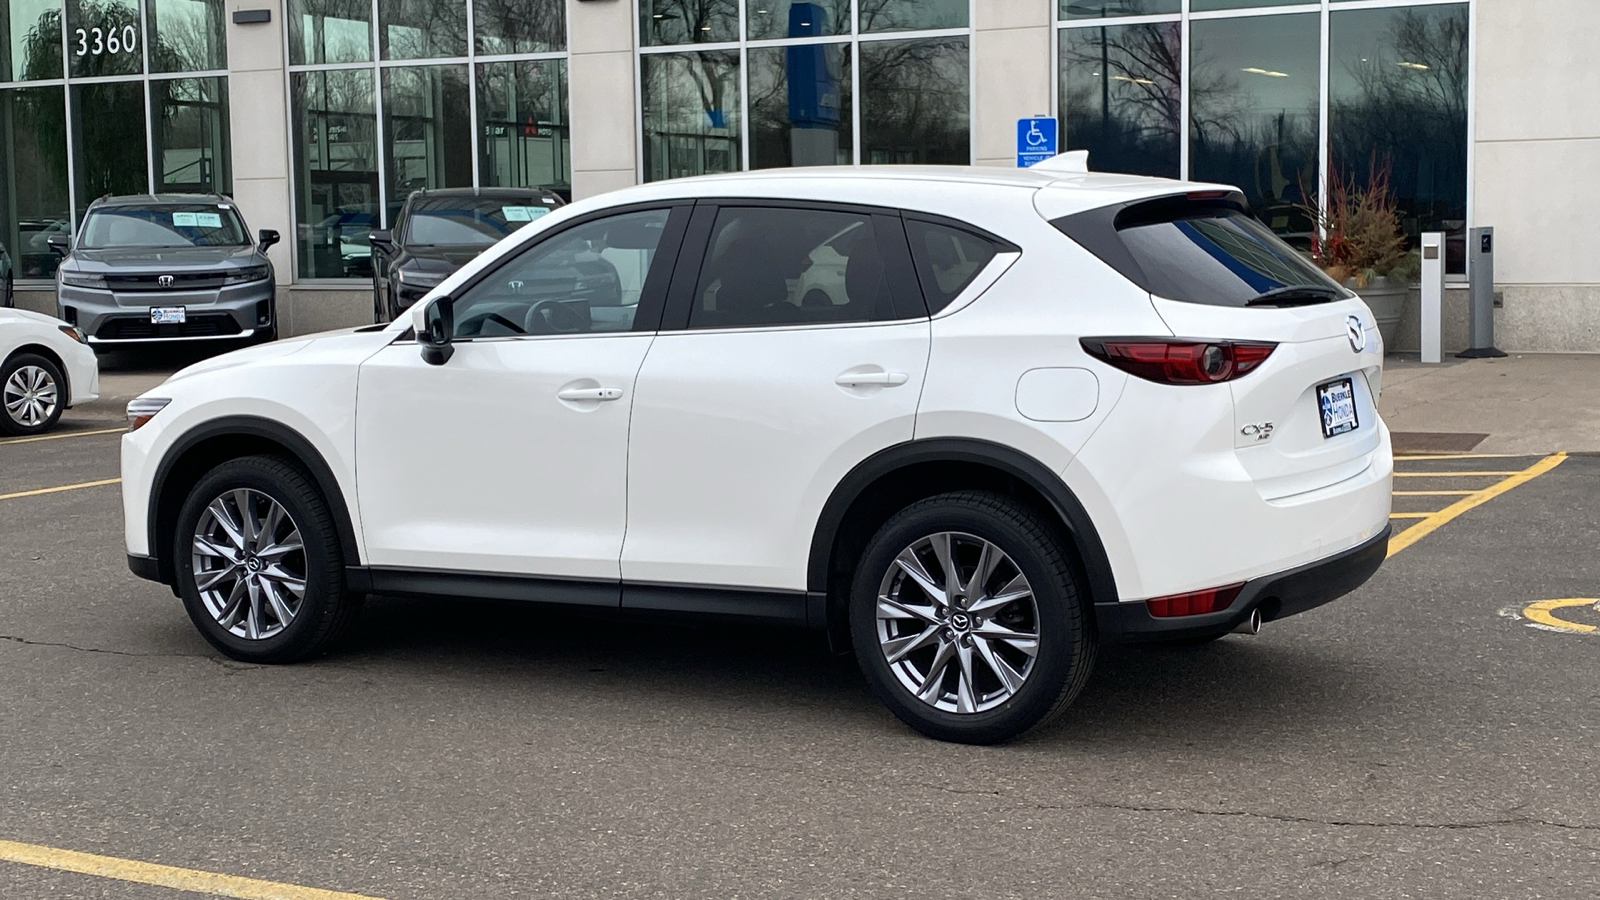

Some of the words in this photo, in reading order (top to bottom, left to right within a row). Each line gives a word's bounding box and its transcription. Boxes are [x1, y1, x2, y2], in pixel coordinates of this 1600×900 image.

[75, 25, 136, 56] 3360
[1331, 390, 1351, 403] BUERKLE
[1333, 402, 1353, 421] HONDA
[1240, 421, 1274, 436] CX-5
